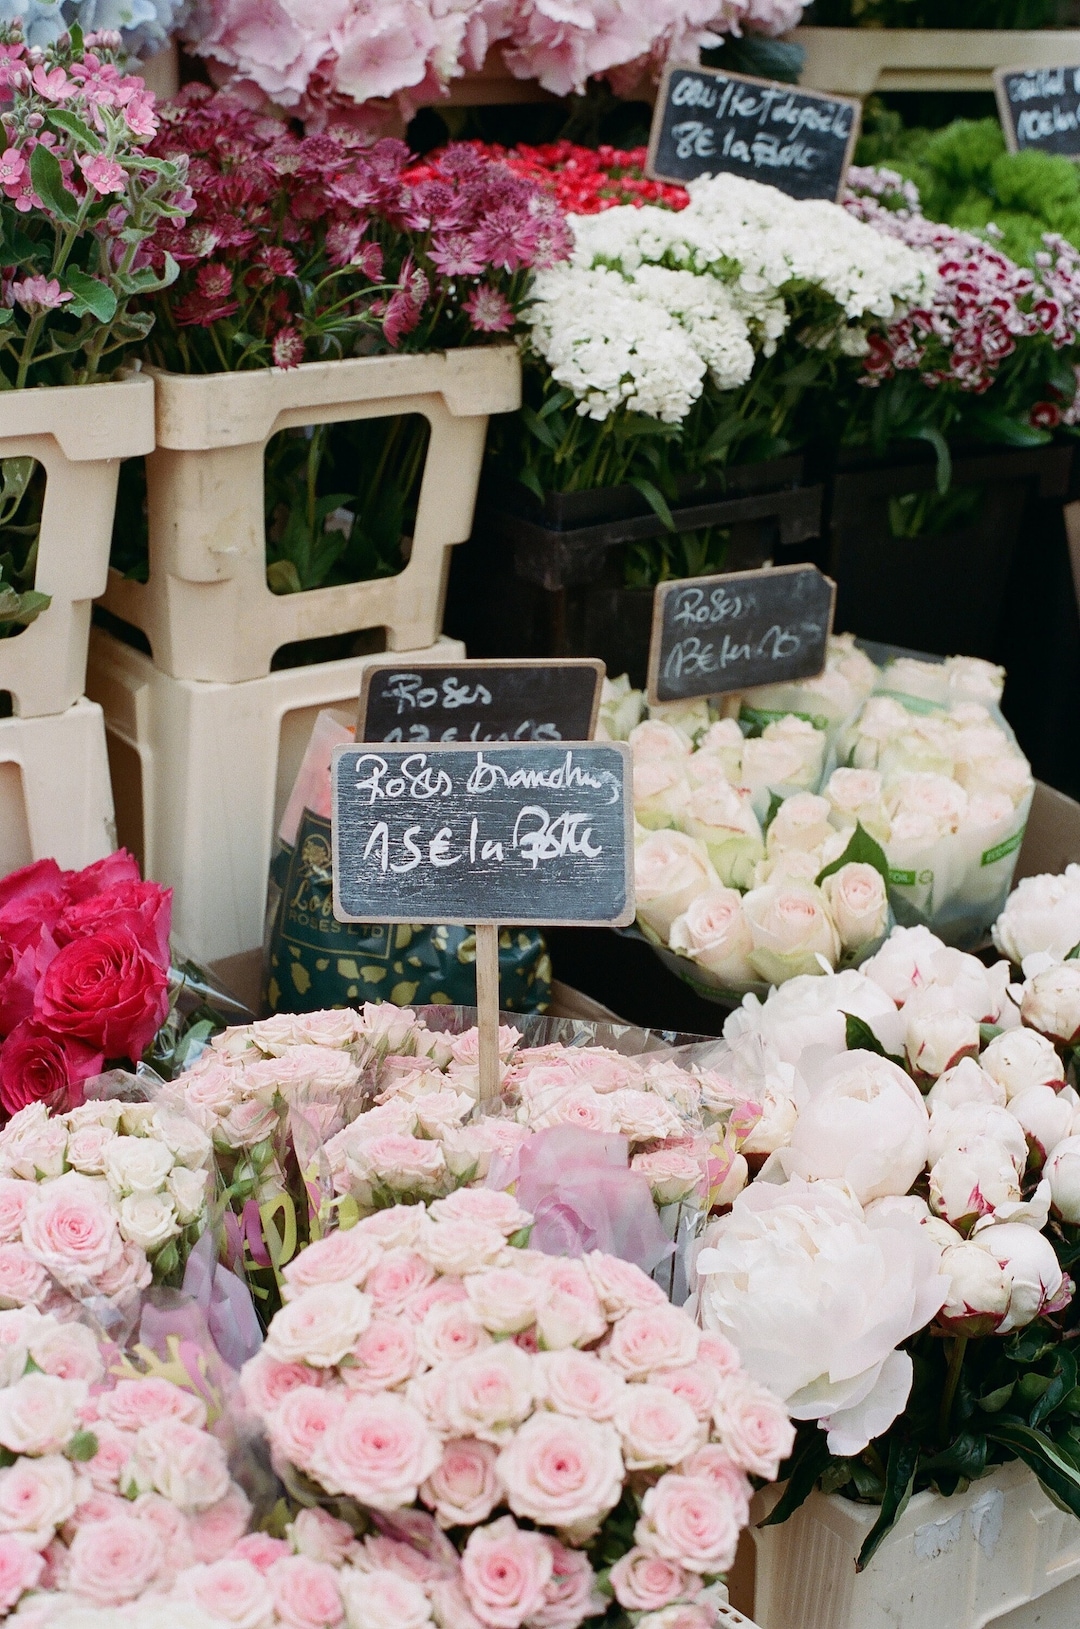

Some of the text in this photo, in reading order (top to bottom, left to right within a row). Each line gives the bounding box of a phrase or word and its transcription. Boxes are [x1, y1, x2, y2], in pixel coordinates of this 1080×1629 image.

[354, 754, 452, 804] Roses
[363, 820, 462, 873] 15€
[471, 817, 504, 863] la
[289, 908, 341, 933] ROSES
